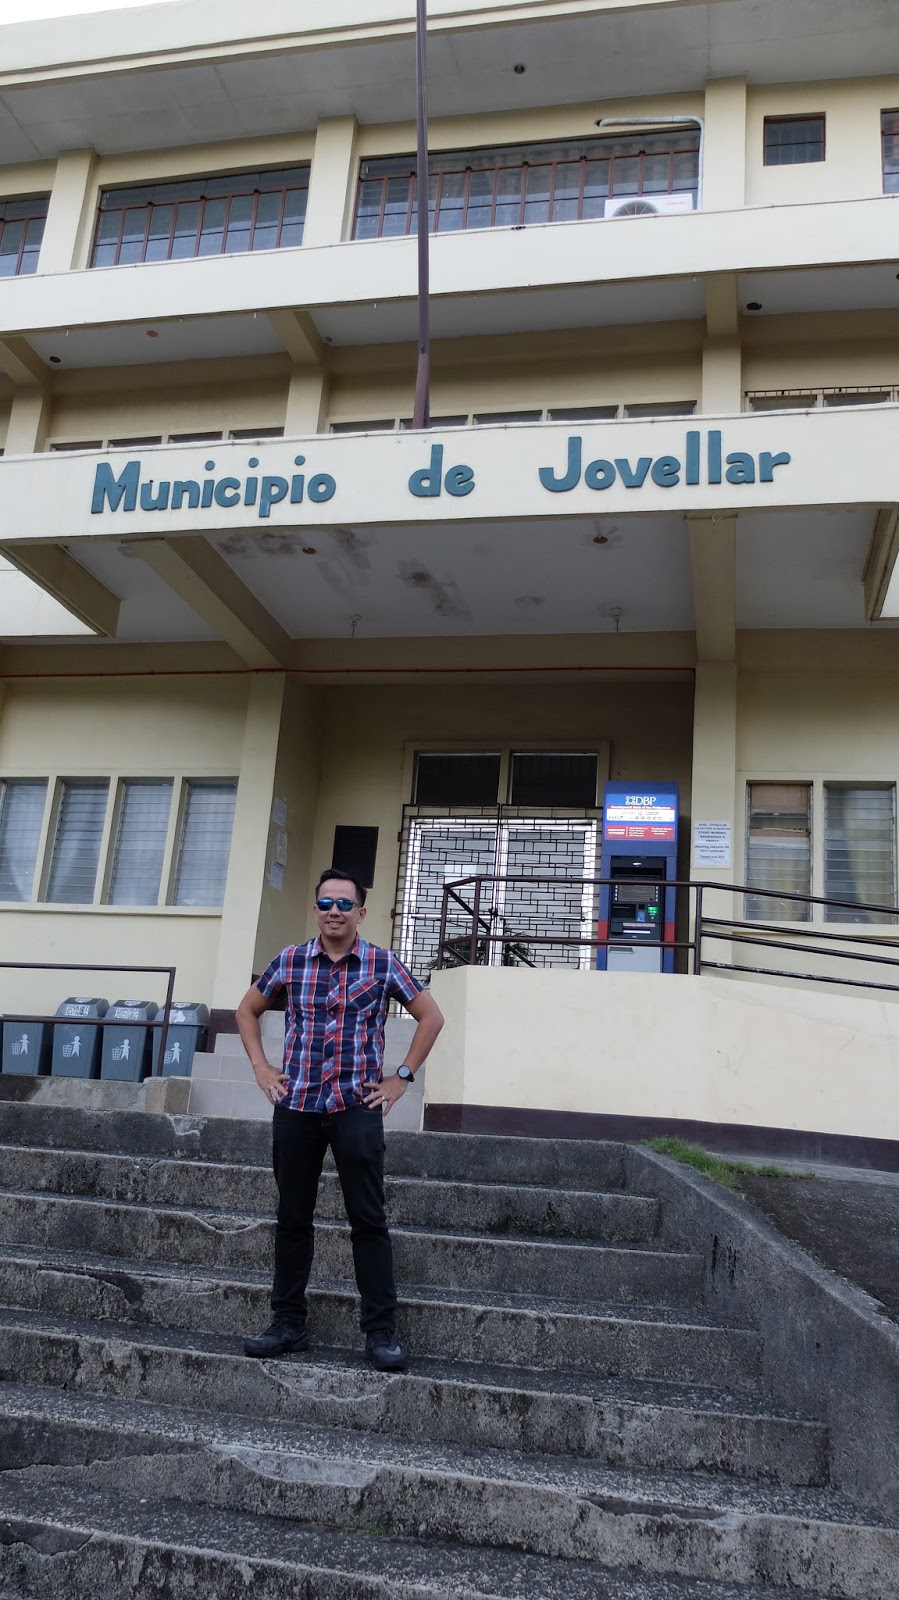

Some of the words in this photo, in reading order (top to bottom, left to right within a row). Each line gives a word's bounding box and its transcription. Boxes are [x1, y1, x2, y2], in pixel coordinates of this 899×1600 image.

[91, 455, 336, 518] Municipio
[408, 444, 475, 497] de
[538, 430, 791, 493] Jovellar
[635, 796, 657, 805] DBP
